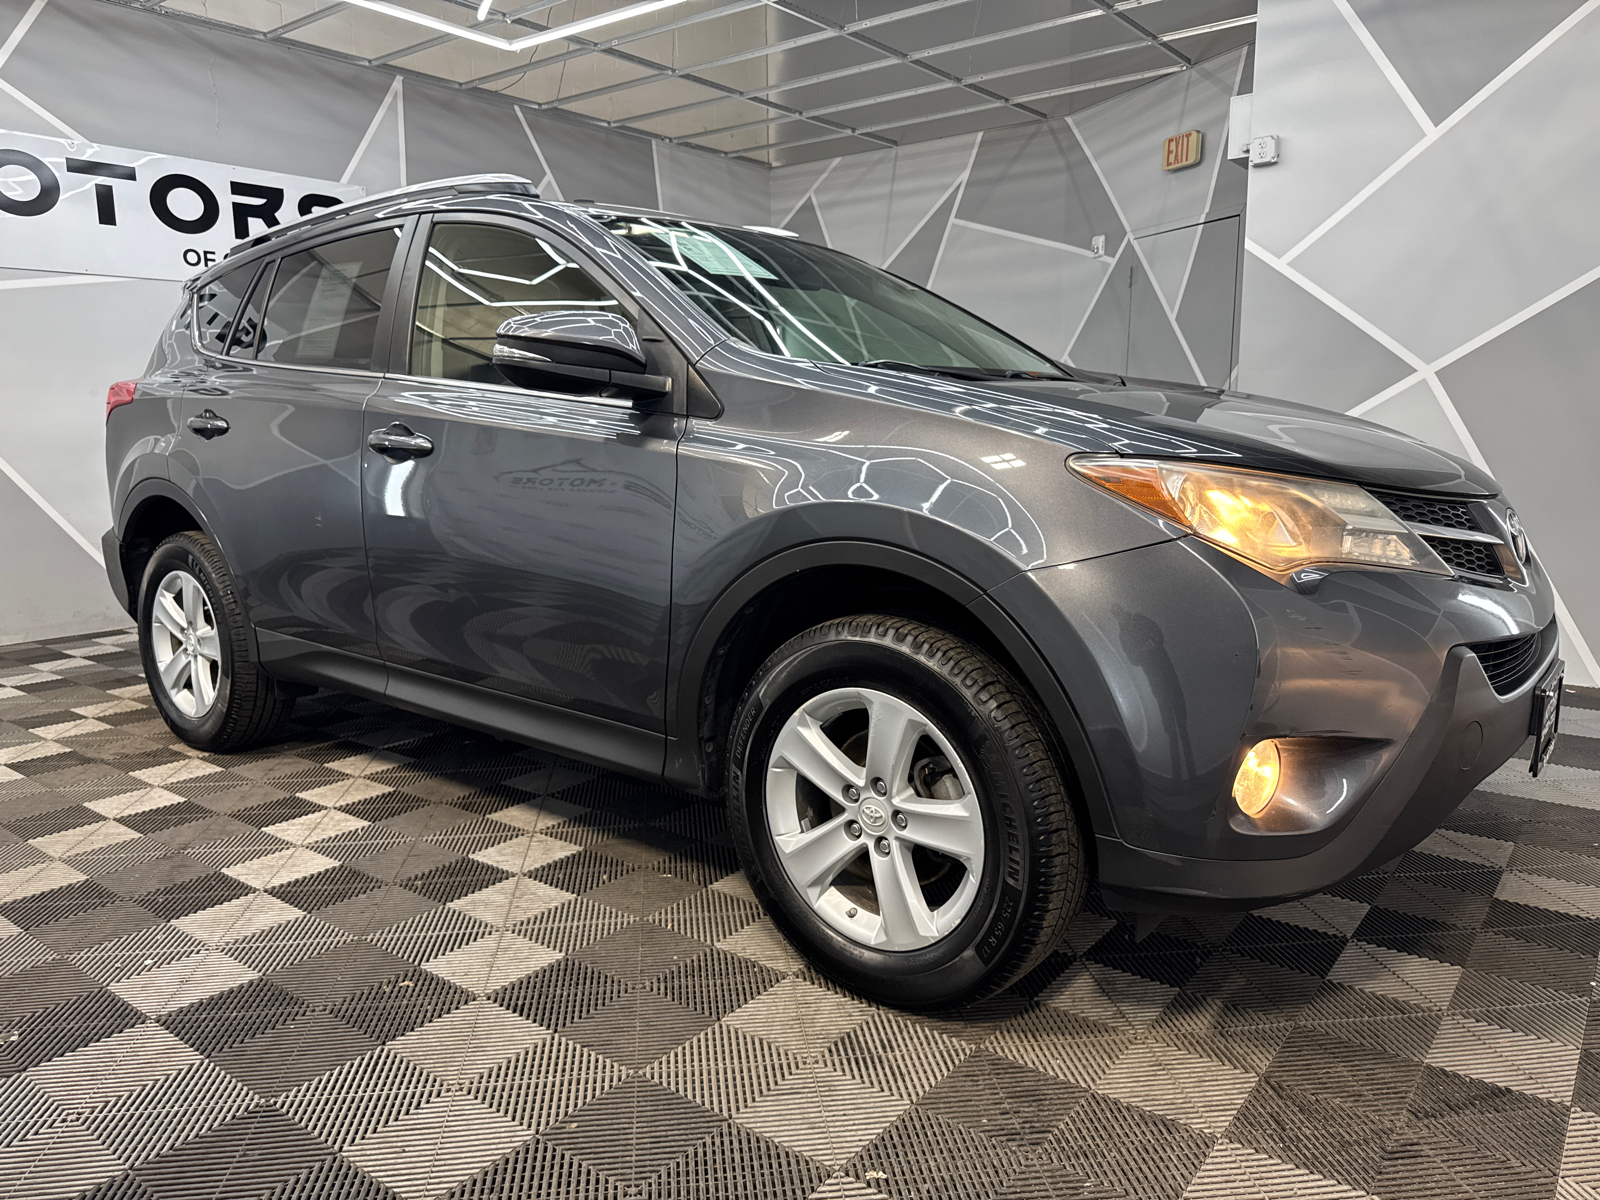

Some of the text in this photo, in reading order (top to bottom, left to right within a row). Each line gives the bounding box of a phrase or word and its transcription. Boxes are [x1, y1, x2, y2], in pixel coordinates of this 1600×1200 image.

[1166, 132, 1192, 167] EXIT
[182, 248, 216, 267] OF
[736, 707, 756, 759] DEFENDER
[991, 771, 1019, 885] MICHELIN
[994, 895, 1014, 940] 225/65
[982, 947, 990, 960] 17
